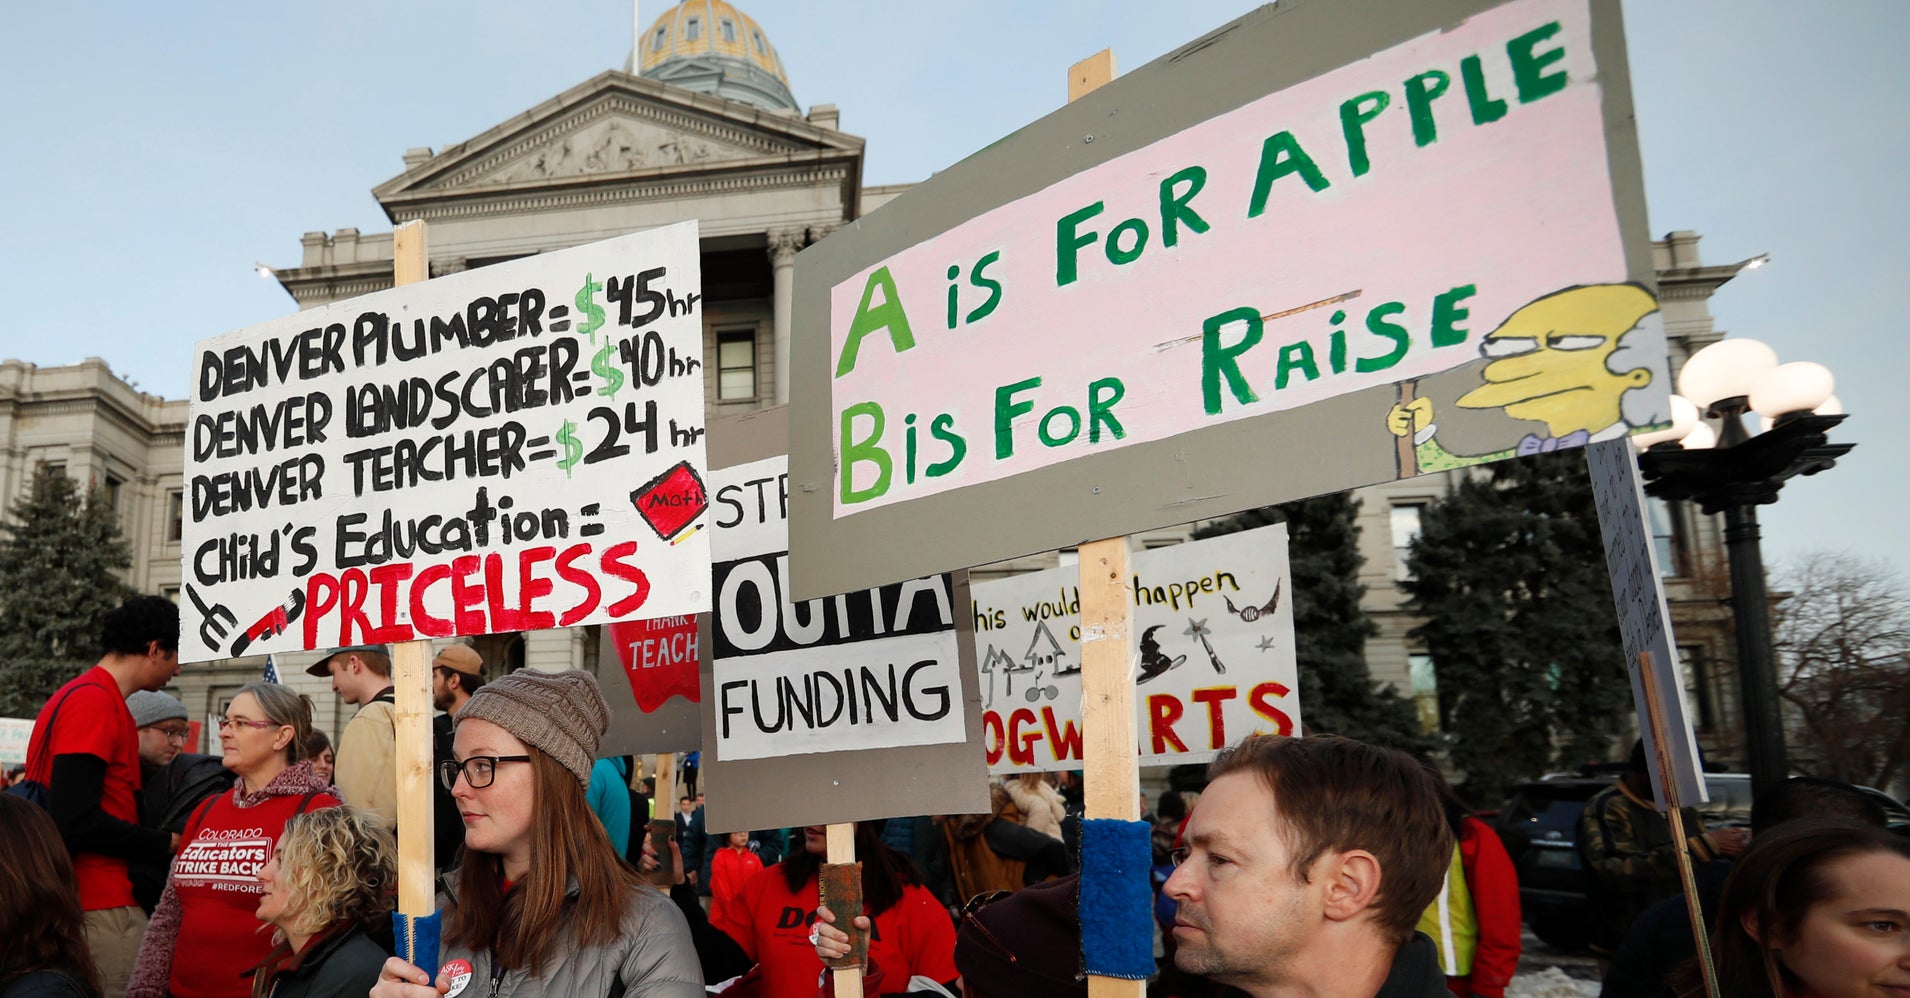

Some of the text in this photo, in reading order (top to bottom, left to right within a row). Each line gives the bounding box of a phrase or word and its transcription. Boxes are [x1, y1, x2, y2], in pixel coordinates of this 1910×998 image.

[836, 267, 915, 379] A
[1248, 21, 1568, 219] APPLE
[199, 323, 346, 401] DENVER
[193, 392, 333, 463] DENVER
[840, 402, 893, 505] B
[191, 453, 325, 522] DENVER
[649, 490, 704, 510] Math
[336, 486, 569, 569] Education
[303, 541, 651, 651] PRICELESS
[973, 599, 1007, 633] his
[1133, 571, 1241, 612] happen
[628, 632, 699, 670] TEACH
[721, 659, 951, 739] FUNDING
[983, 681, 1296, 766] OGWRTS
[179, 846, 265, 861] Educators
[198, 827, 263, 841] COLORADO
[219, 861, 265, 876] BACK
[211, 883, 264, 894] #REDFORE
